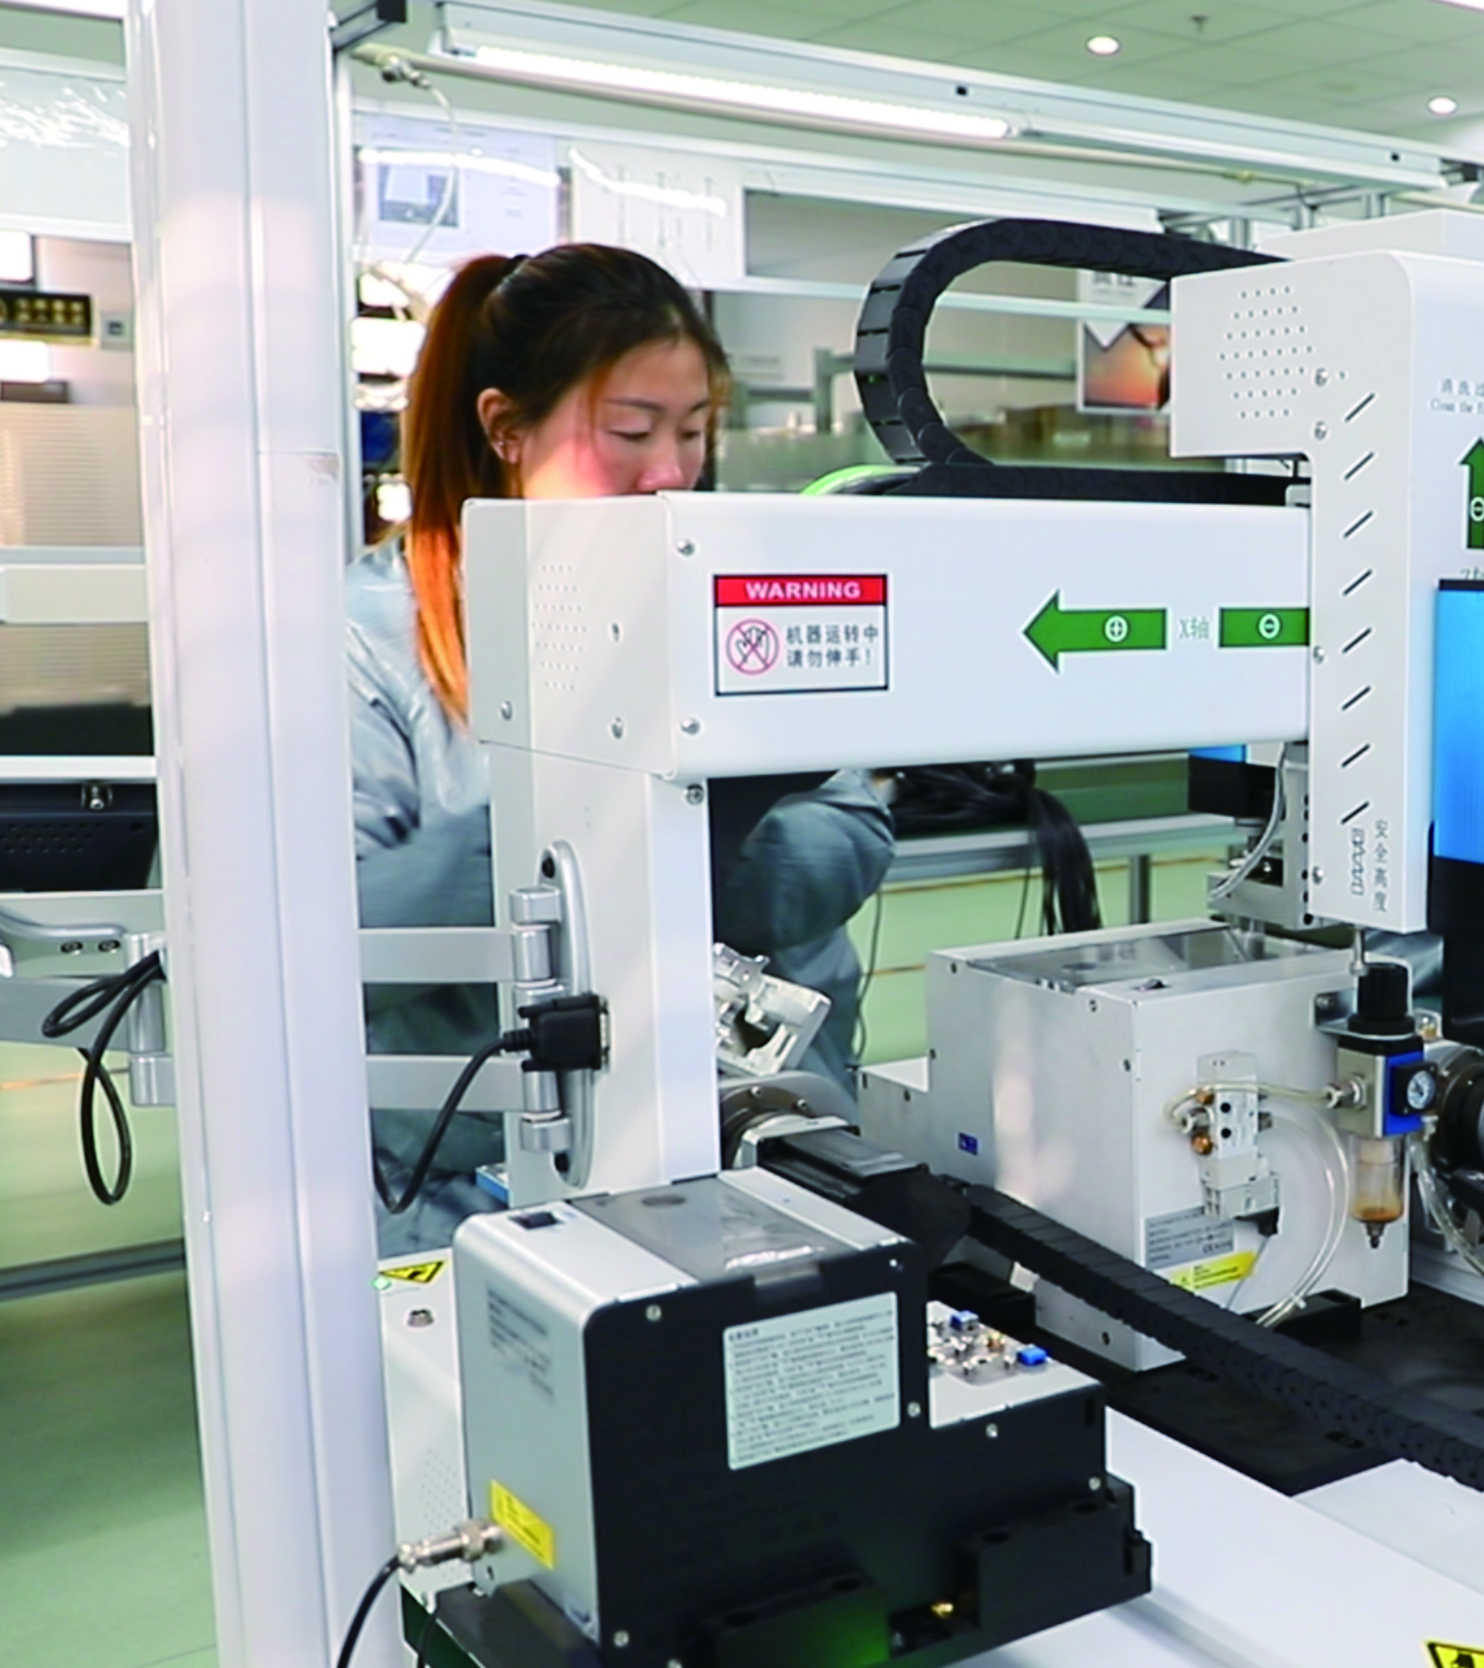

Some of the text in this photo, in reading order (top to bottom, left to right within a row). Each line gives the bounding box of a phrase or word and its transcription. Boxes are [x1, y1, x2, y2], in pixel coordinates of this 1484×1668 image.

[745, 581, 863, 600] WARNING
[786, 624, 879, 645] 机器运转中
